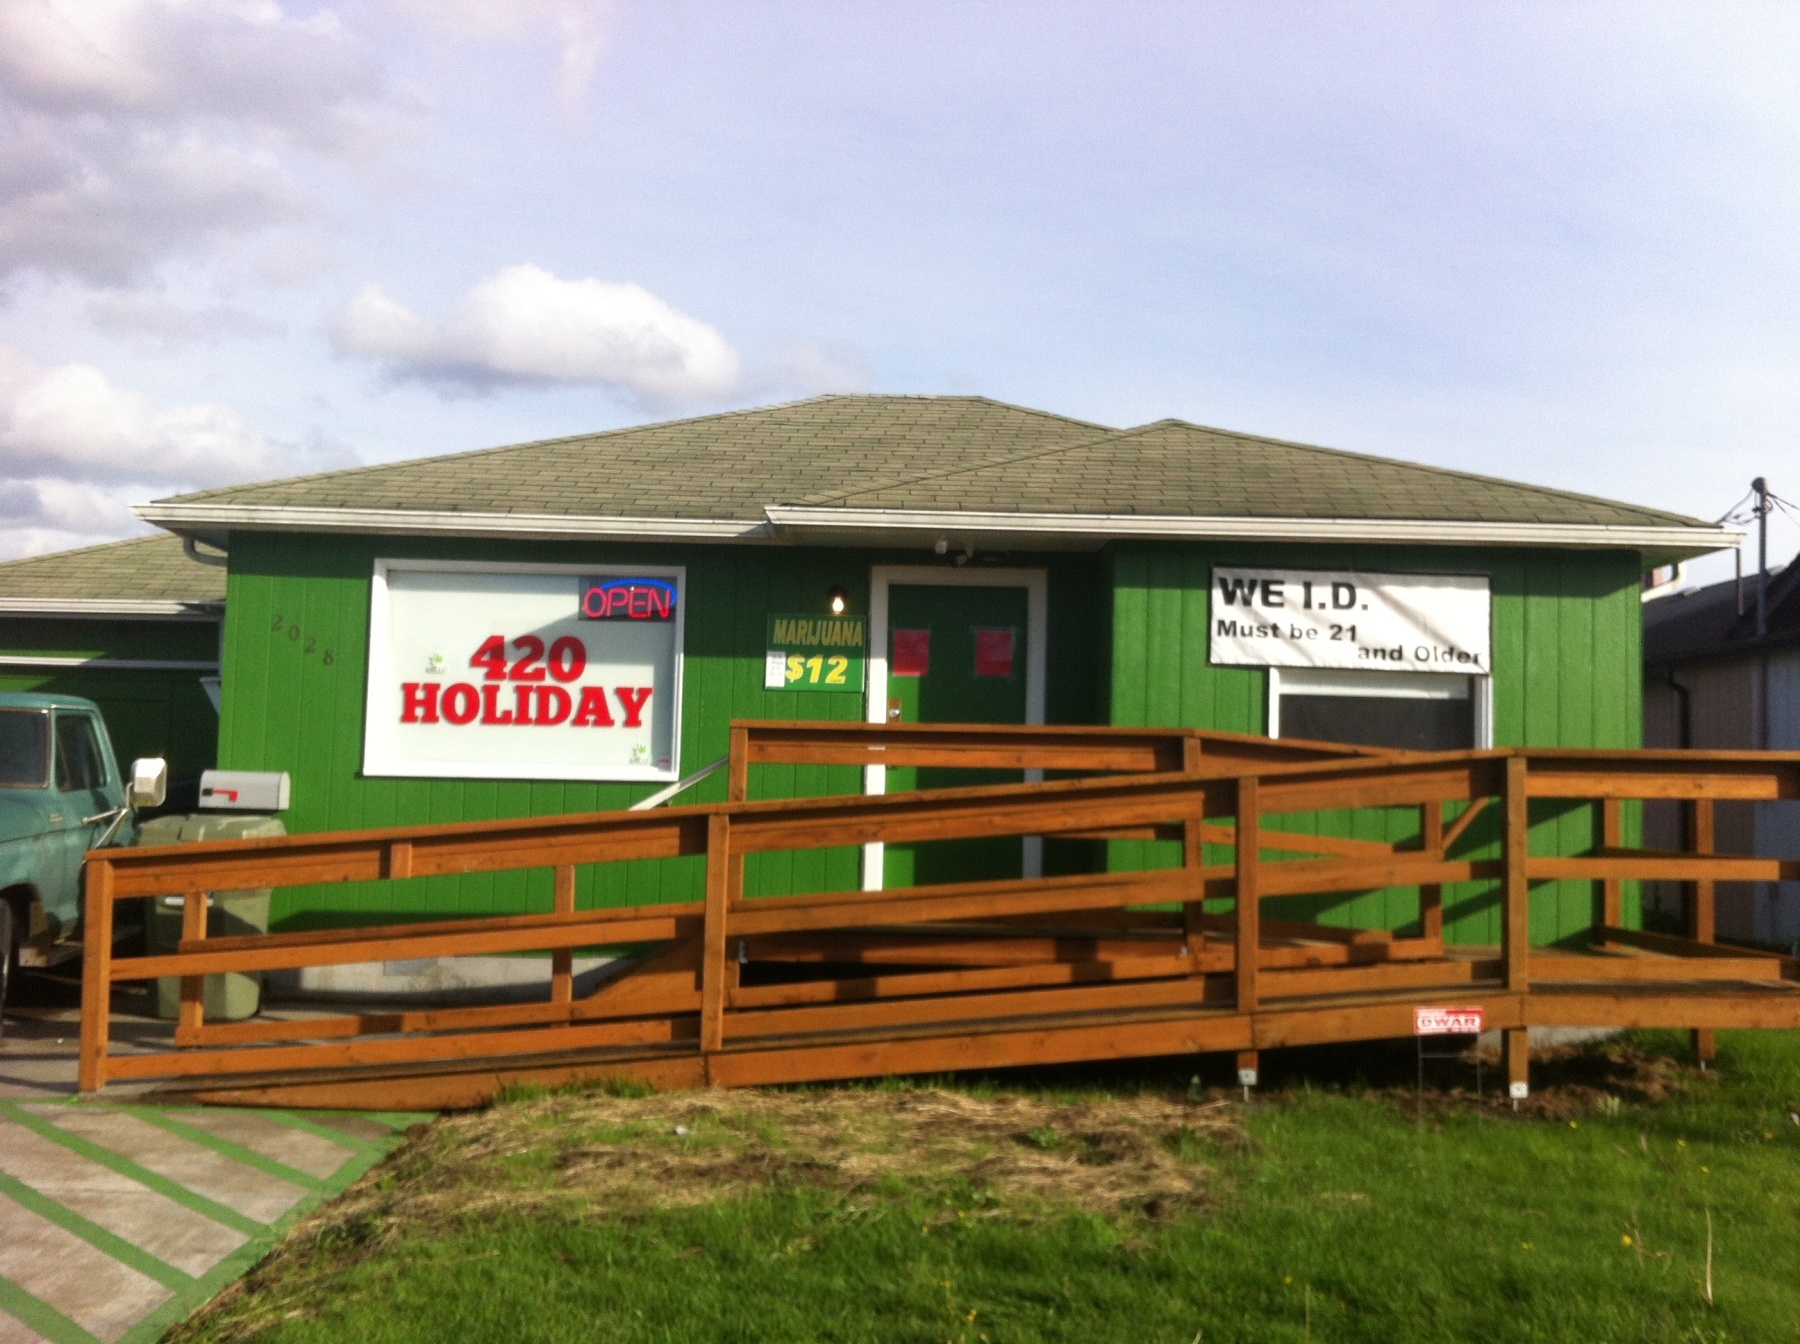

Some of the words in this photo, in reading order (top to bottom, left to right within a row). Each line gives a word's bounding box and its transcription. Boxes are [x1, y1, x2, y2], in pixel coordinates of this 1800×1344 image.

[584, 587, 671, 619] OPEN
[1219, 577, 1285, 608] WE
[1303, 581, 1369, 611] I.D.
[271, 613, 334, 666] 2028
[773, 619, 862, 646] MARIJUANA
[1217, 620, 1280, 639] Must
[1290, 623, 1318, 640] be
[1329, 624, 1357, 641] 21
[470, 635, 587, 682] 420
[785, 654, 848, 684] $12
[1358, 645, 1403, 662] and
[1414, 646, 1482, 665] Older
[401, 682, 653, 727] HOLIDAY
